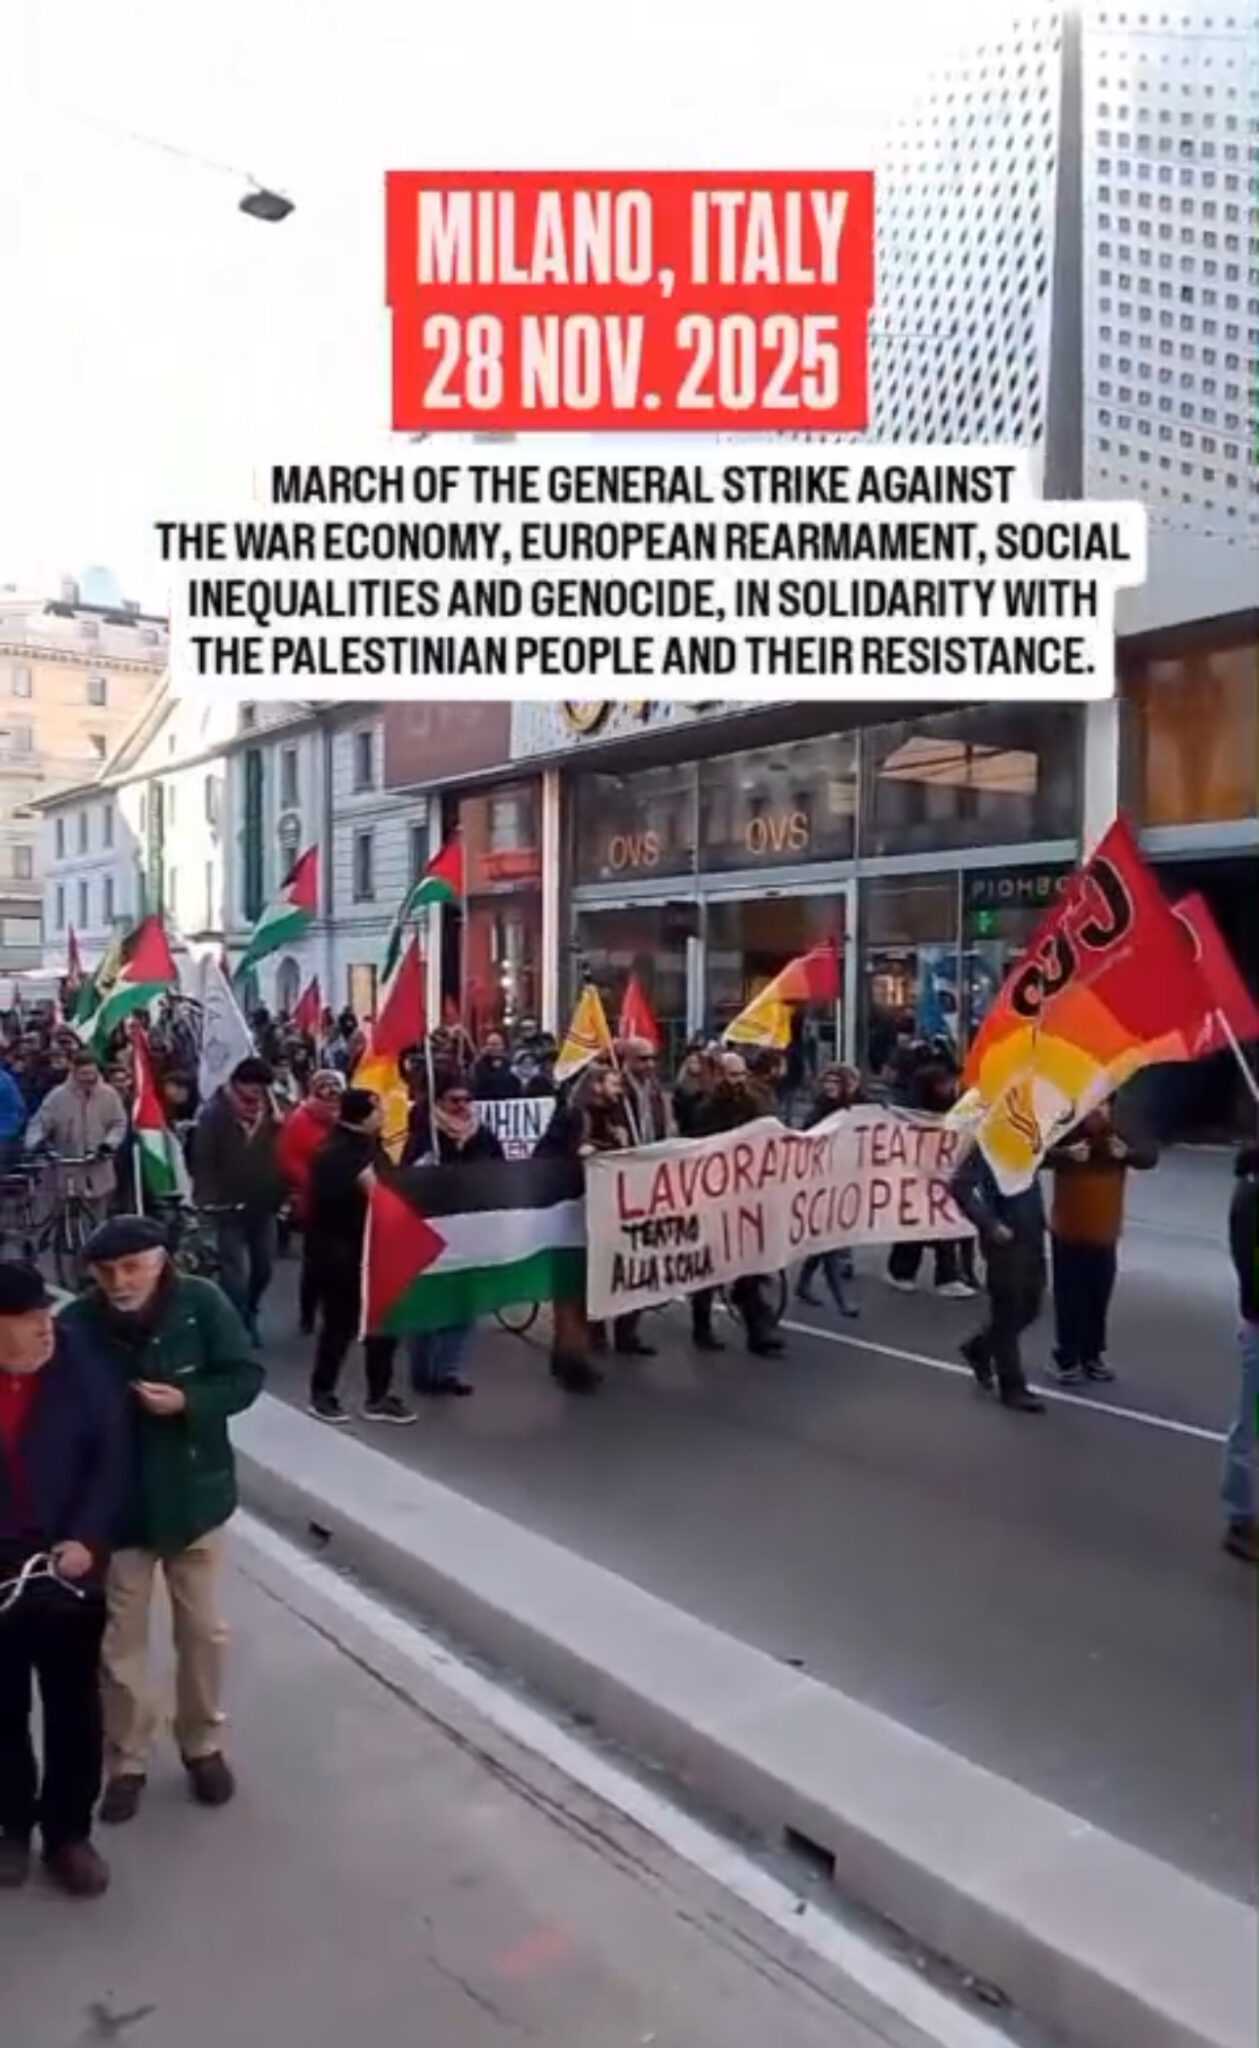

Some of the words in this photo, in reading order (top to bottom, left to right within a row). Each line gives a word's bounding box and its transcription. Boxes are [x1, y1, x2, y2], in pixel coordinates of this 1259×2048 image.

[608, 829, 660, 870] OVS
[745, 811, 810, 855] OVS
[853, 1122, 958, 1170] TEATR
[721, 1203, 766, 1263] IN
[789, 1178, 957, 1246] SCIOPER
